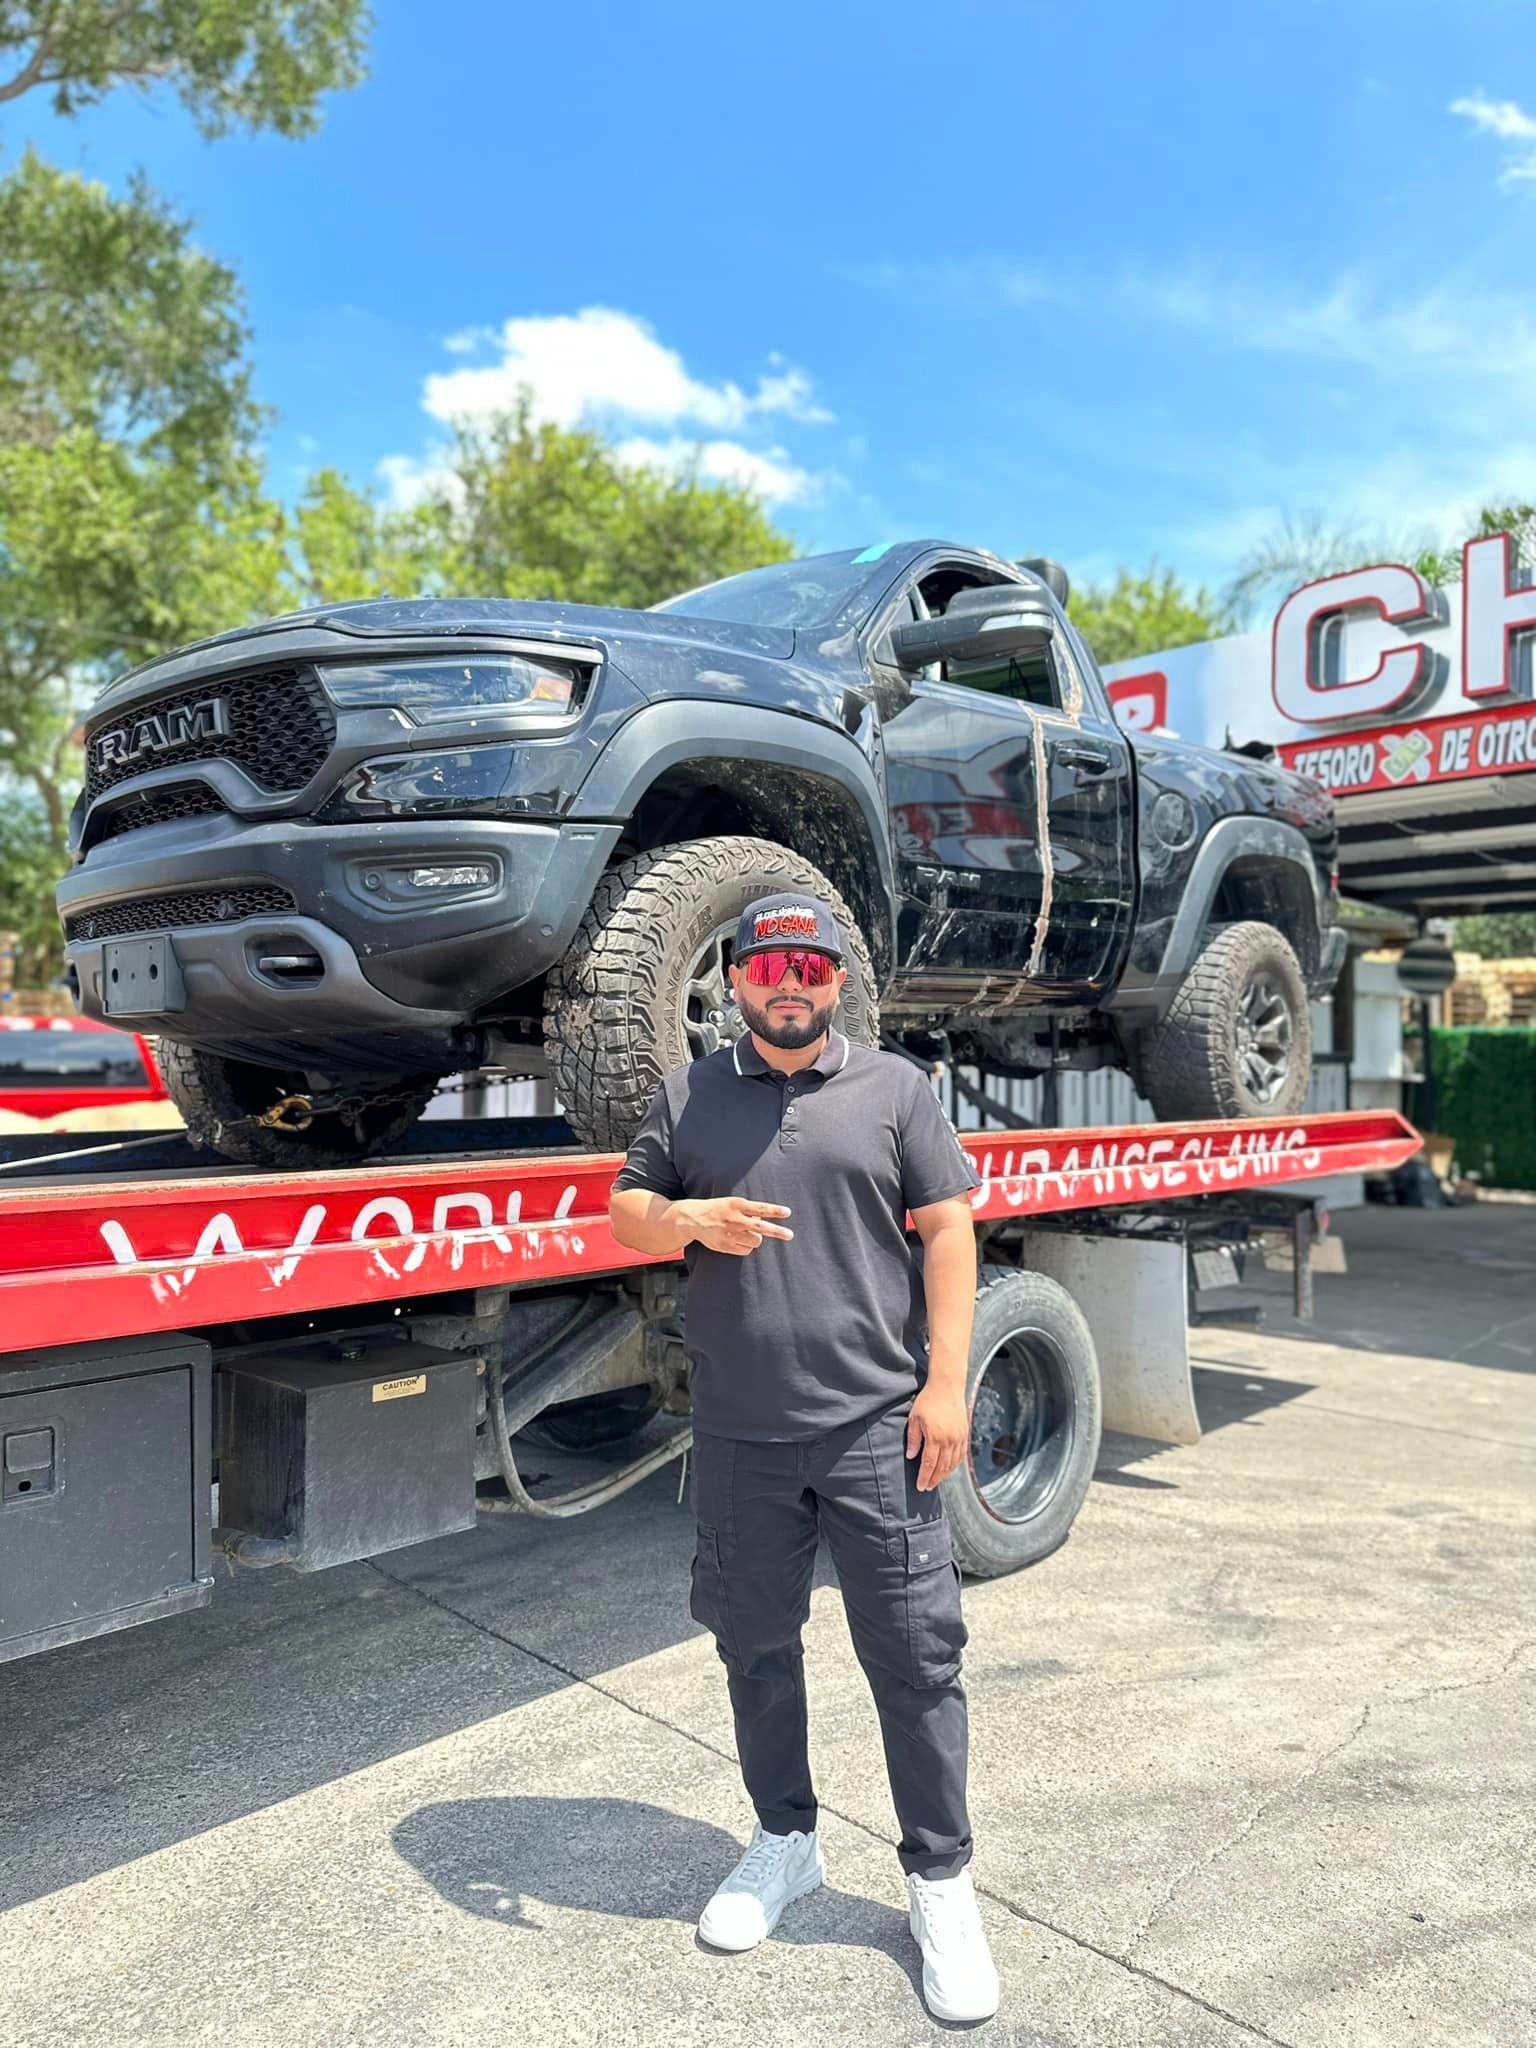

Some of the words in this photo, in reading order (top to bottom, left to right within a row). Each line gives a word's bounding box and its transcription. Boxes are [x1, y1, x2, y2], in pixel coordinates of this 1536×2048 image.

[97, 698, 229, 772] RAM
[1439, 726, 1474, 773] DE
[916, 865, 982, 889] RAM
[100, 1185, 586, 1300] WORK
[1180, 1128, 1322, 1185] CLAIMS
[382, 1379, 417, 1391] CAUTION
